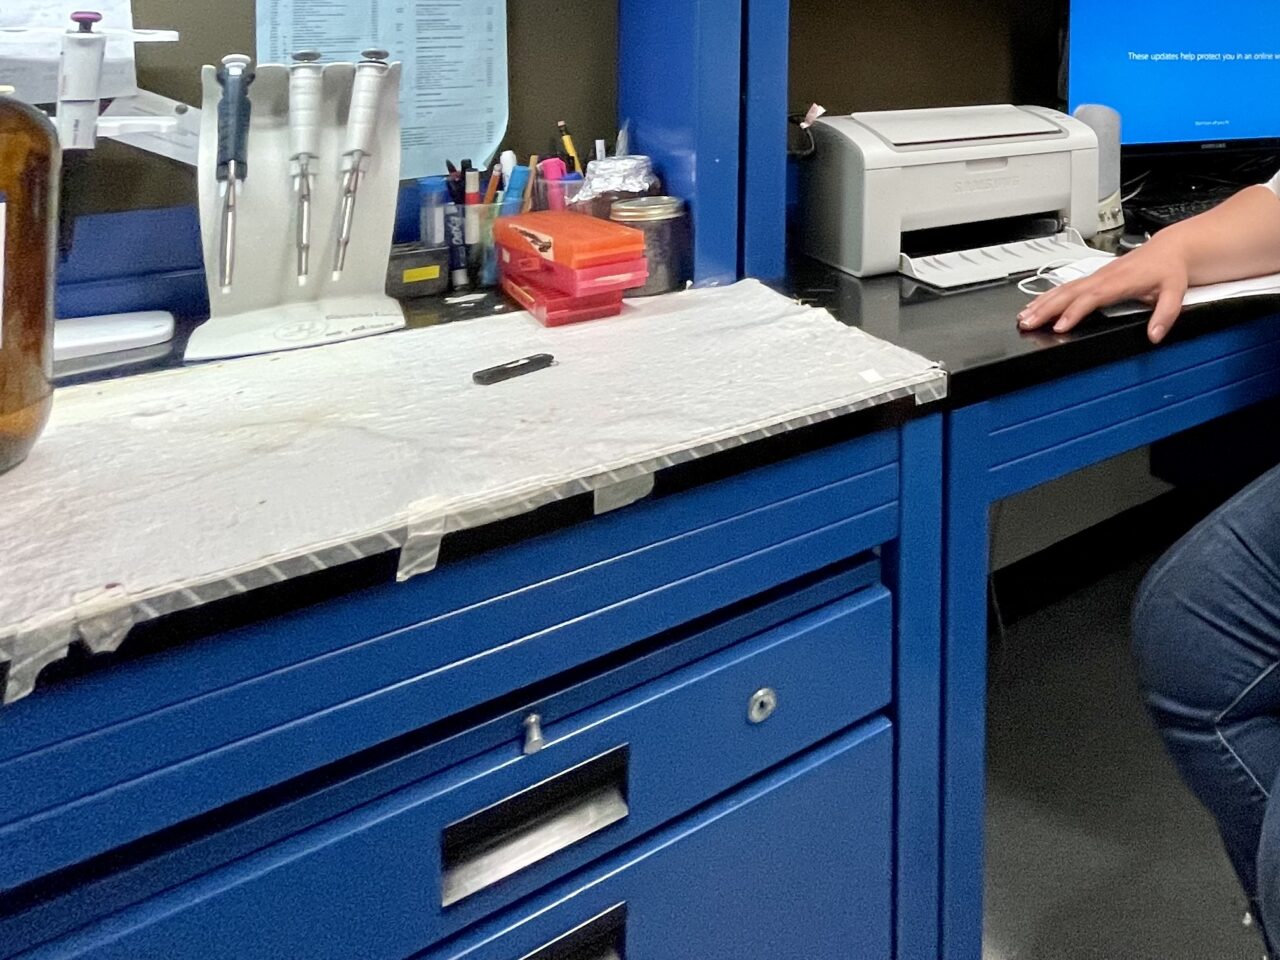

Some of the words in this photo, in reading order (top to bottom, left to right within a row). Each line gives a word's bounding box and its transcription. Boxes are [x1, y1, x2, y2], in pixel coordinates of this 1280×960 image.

[1128, 51, 1149, 60] These
[1150, 51, 1178, 62] updates
[1180, 51, 1195, 62] help
[1197, 52, 1221, 62] protect
[1222, 53, 1235, 62] you
[1236, 52, 1243, 60] in
[1253, 51, 1273, 60] online
